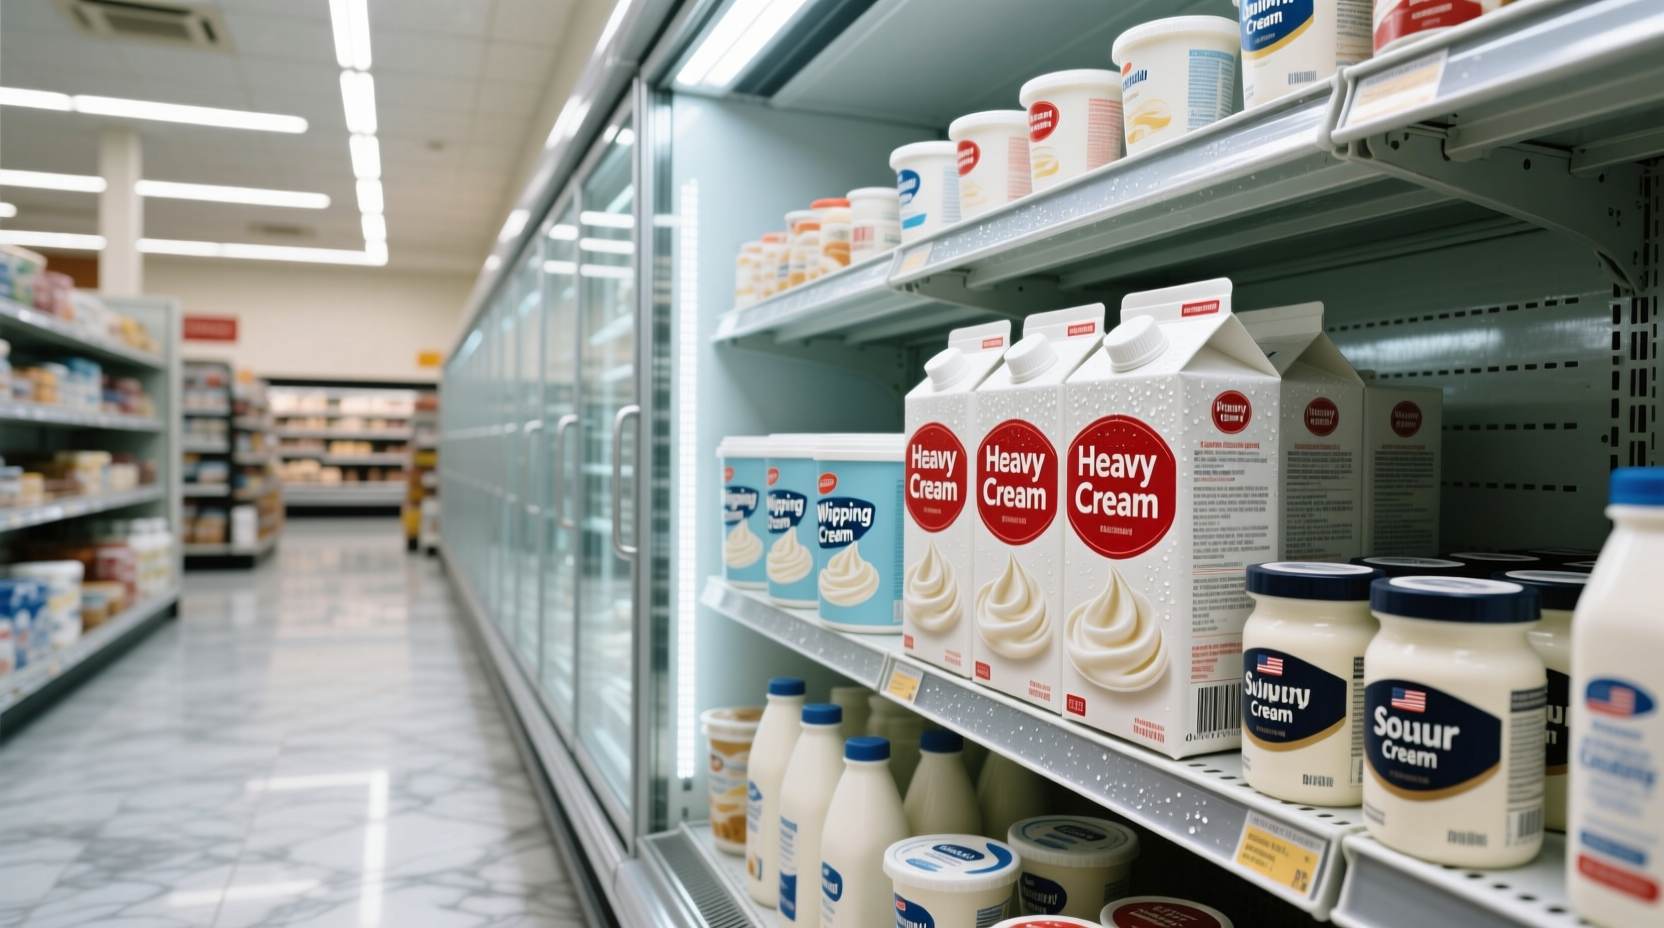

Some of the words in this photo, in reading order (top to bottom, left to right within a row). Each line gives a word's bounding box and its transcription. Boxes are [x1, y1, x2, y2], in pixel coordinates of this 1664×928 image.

[911, 444, 957, 477] Heavy
[985, 445, 1046, 482] Heavy
[1078, 445, 1157, 488] Heavy
[909, 474, 958, 501] Cream
[983, 477, 1047, 510] Cream
[1075, 482, 1159, 519] Cream
[817, 501, 872, 527] Wipping
[818, 525, 854, 543] Cream
[1250, 700, 1293, 723] Cream
